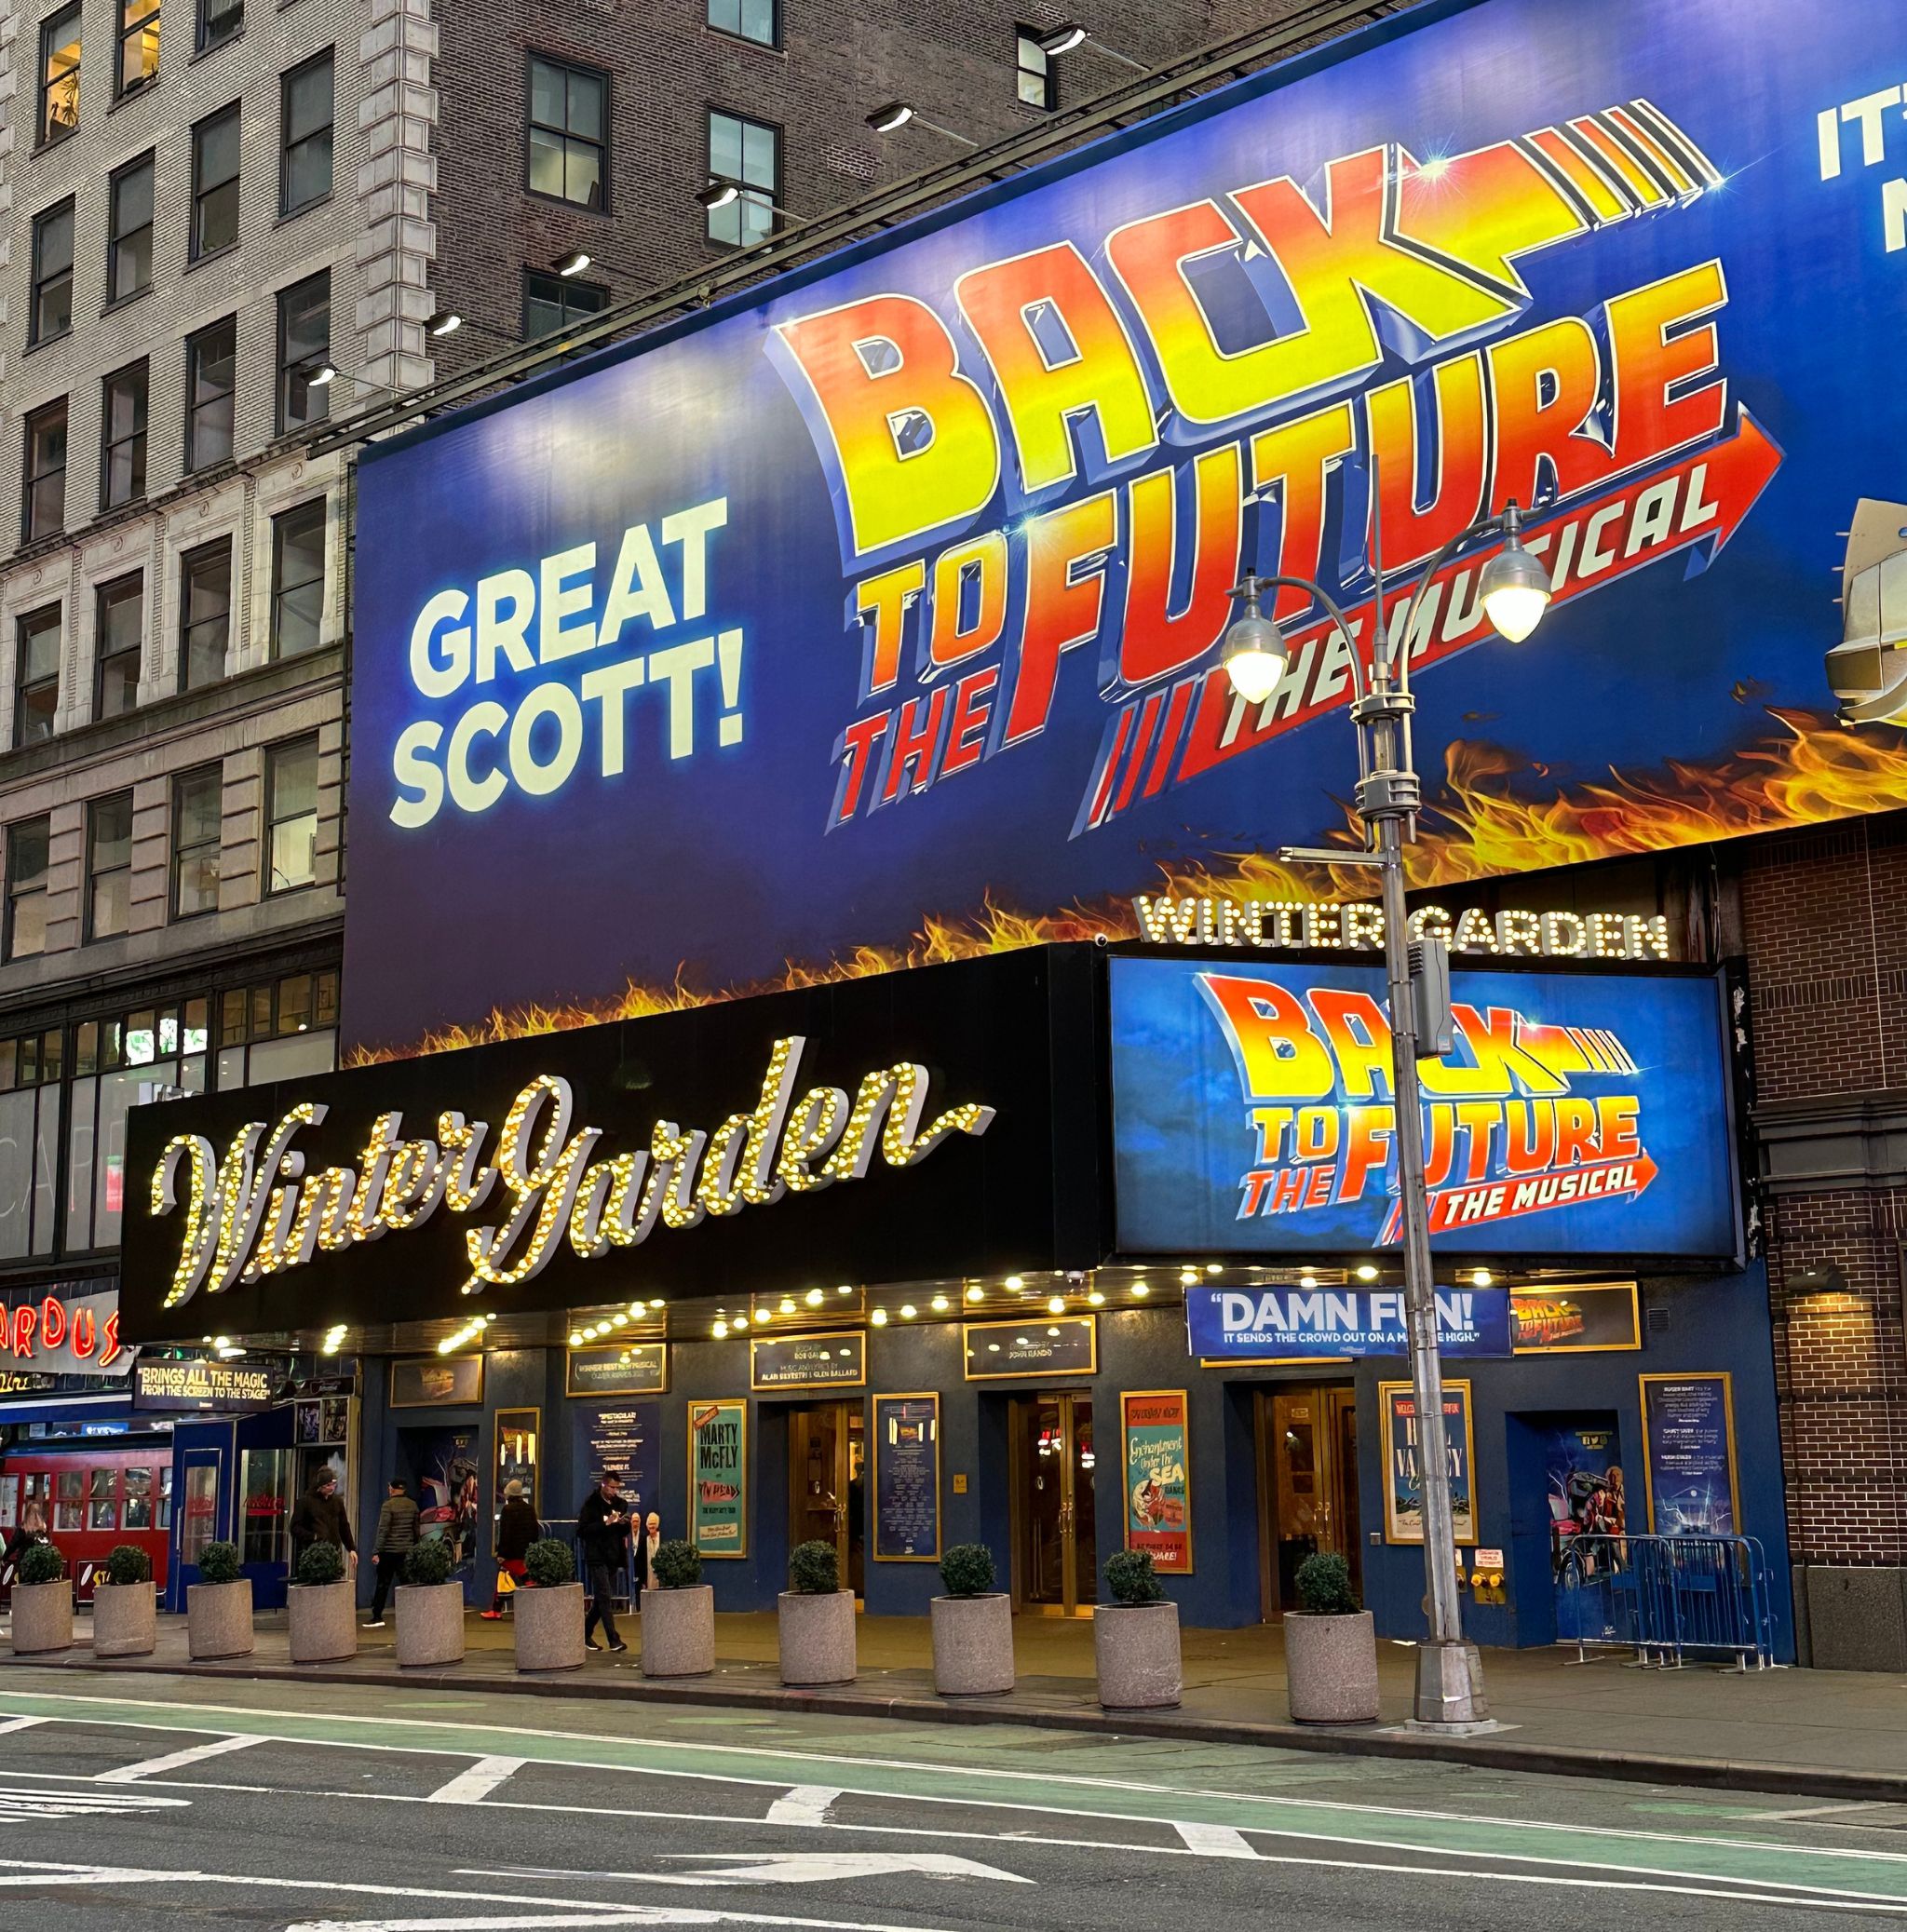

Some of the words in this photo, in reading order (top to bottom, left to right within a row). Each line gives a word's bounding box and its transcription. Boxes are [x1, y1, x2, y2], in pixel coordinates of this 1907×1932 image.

[1818, 82, 1907, 182] IT
[768, 98, 1724, 570] BACK
[847, 527, 1009, 700] TO
[994, 258, 1729, 752] FUTURE
[1386, 463, 1720, 667] MUICAL
[410, 496, 727, 698] GREAT
[389, 628, 743, 828] SCOTT!
[830, 663, 1000, 831] THE
[1133, 895, 1386, 951] WINTER
[1407, 905, 1670, 960] GARDEN
[1246, 1105, 1339, 1167] TO
[151, 1102, 491, 1309] Winter
[460, 1034, 996, 1295] Garden
[1236, 1165, 1335, 1221] THE
[1444, 1185, 1504, 1225] THE
[1511, 1163, 1638, 1211] MUSICAL
[1224, 1333, 1234, 1343] IT
[1237, 1332, 1273, 1343] SENDS
[1275, 1332, 1297, 1343] THE
[1298, 1332, 1341, 1343] CROWD
[1343, 1332, 1366, 1342] OUT
[1368, 1332, 1385, 1342] ON
[1386, 1332, 1396, 1342] A
[142, 1384, 165, 1396] FROM
[166, 1385, 182, 1397] THE
[215, 1387, 224, 1398] TO
[226, 1388, 241, 1398] THE
[186, 1369, 209, 1386] ALL
[210, 1370, 233, 1386] THE
[234, 1371, 268, 1389] MAGIC
[700, 1423, 737, 1445] MARTY
[700, 1446, 737, 1468] McFLY
[1149, 1463, 1185, 1487] SEA
